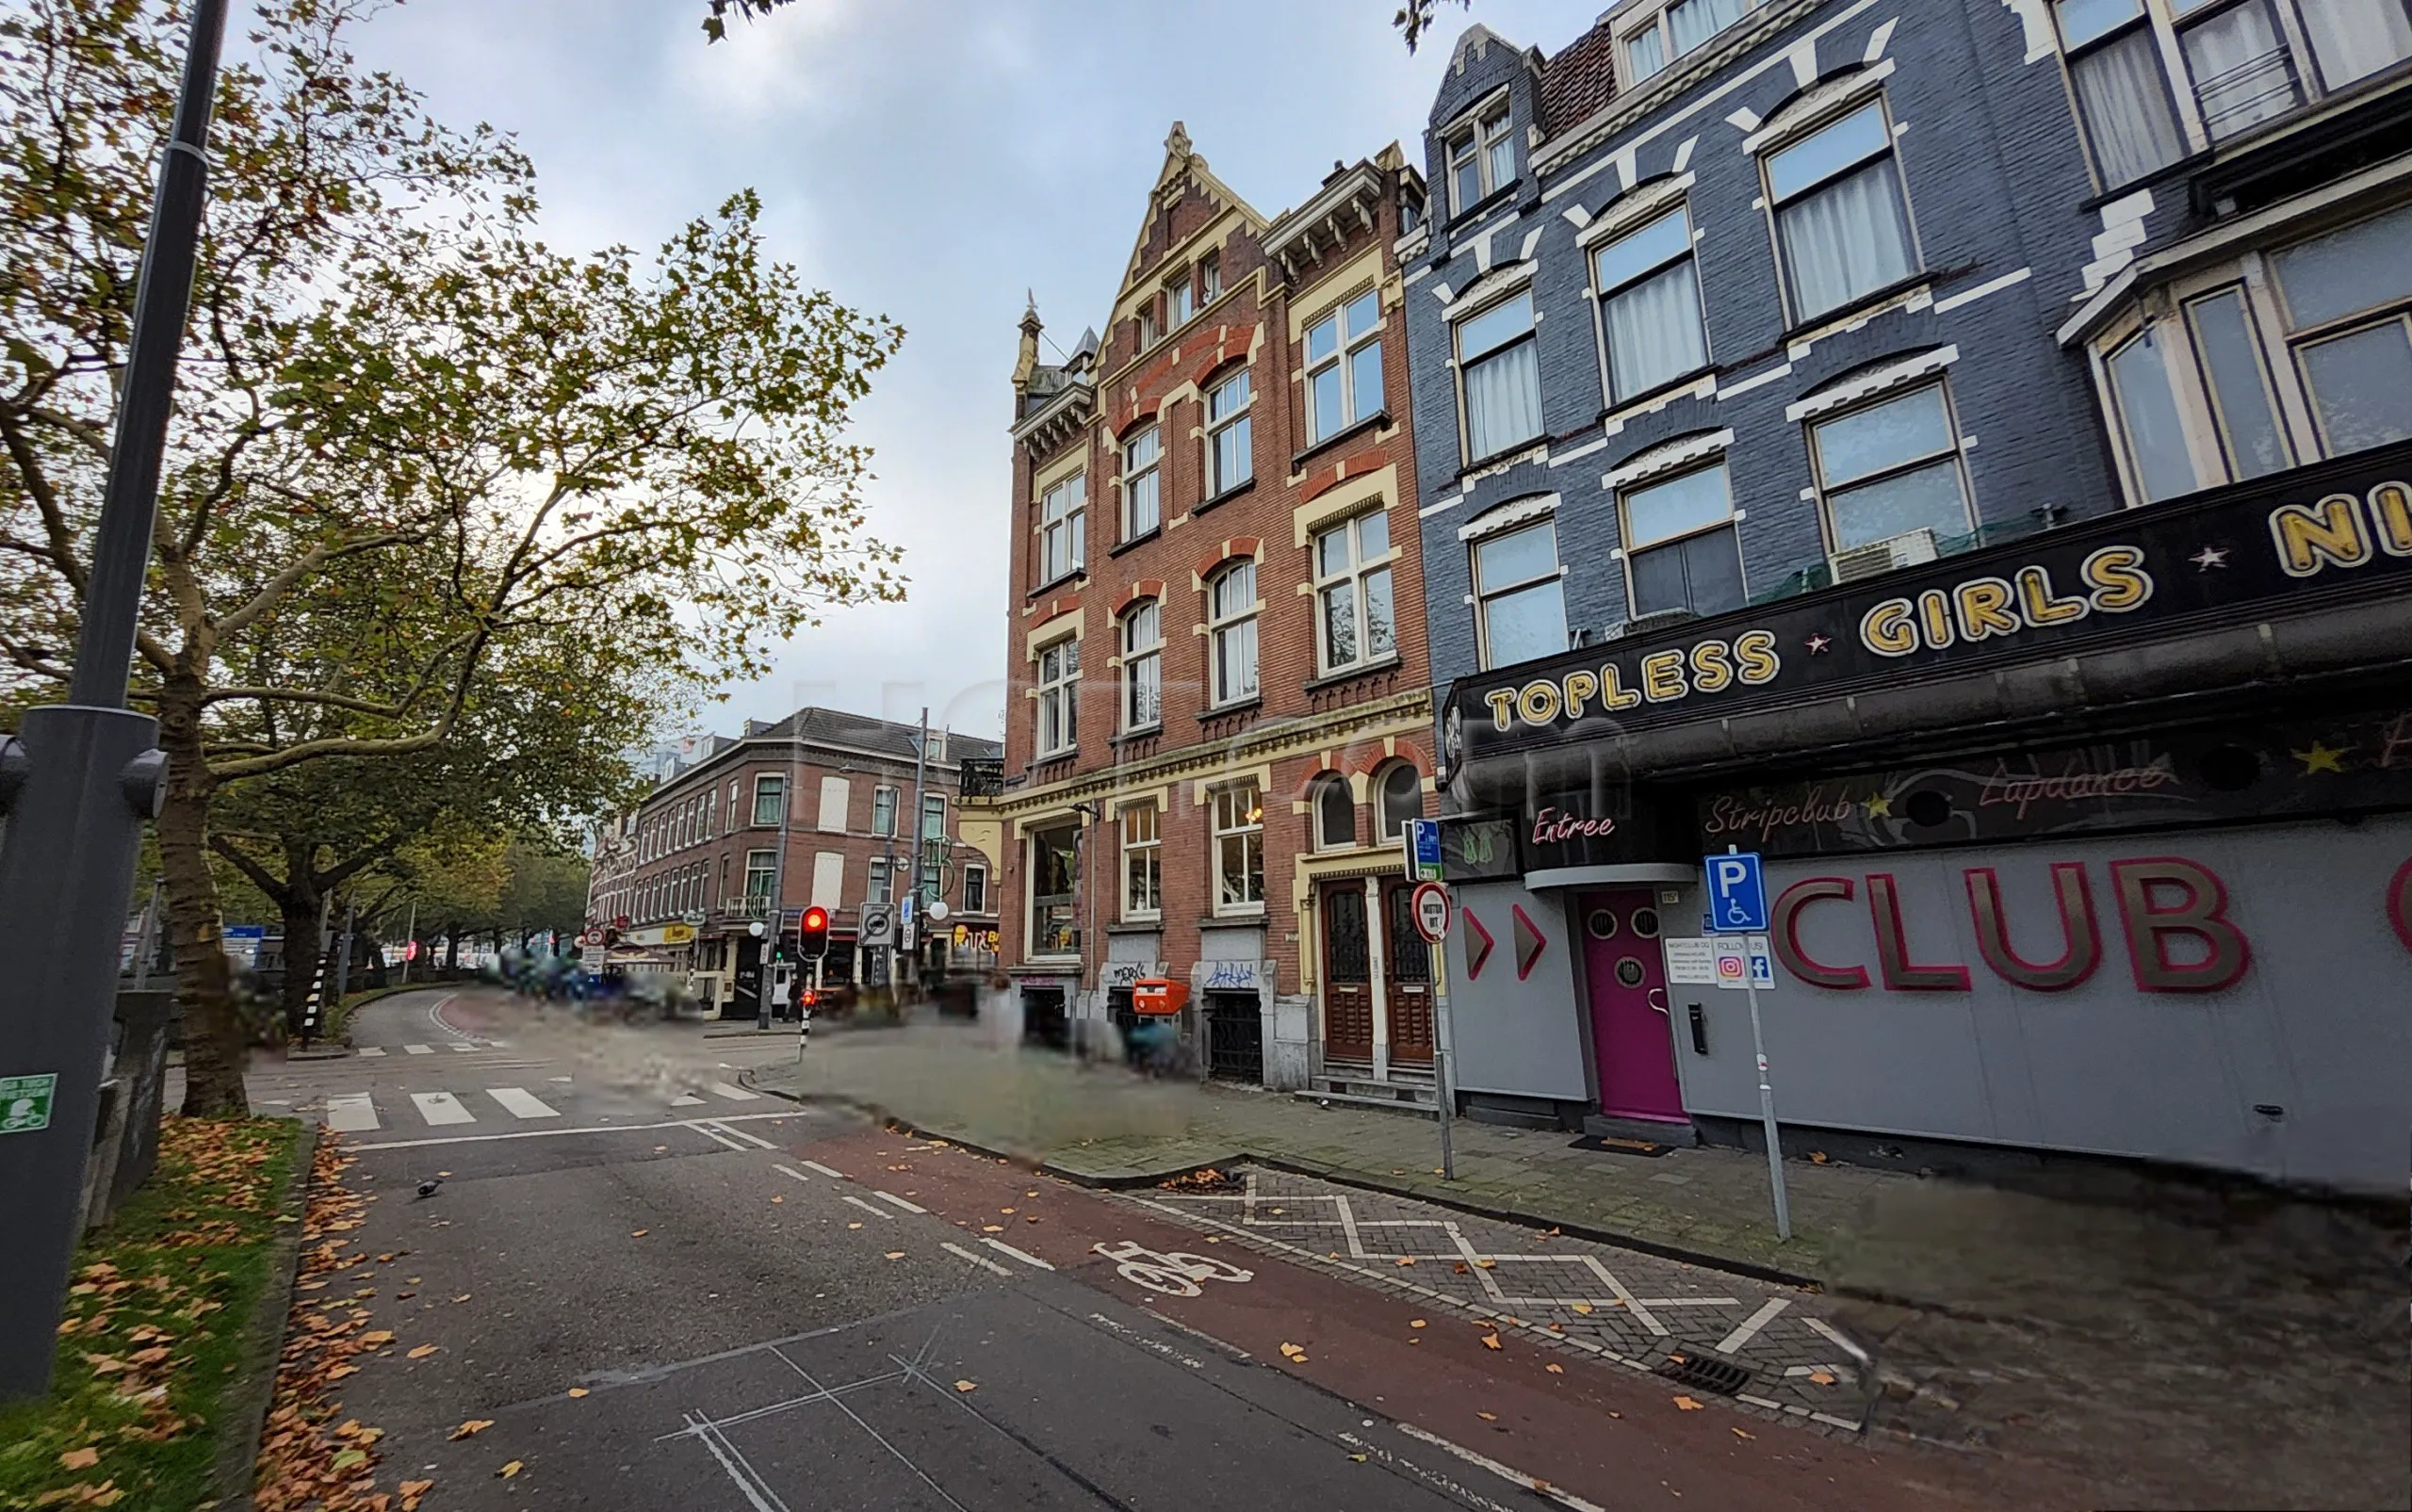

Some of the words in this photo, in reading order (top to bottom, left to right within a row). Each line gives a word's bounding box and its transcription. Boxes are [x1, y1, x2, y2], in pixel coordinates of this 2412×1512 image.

[1485, 629, 1781, 732] TOPLESS
[1859, 545, 2154, 658] GIRLS
[2269, 480, 2412, 577] NI
[1532, 806, 1615, 845] Entree
[1704, 785, 1851, 843] Stripclub
[1718, 861, 1747, 898] P
[1423, 903, 1442, 914] MOTOR
[1770, 855, 2252, 993] CLUB
[1718, 942, 1743, 951] FOLLO
